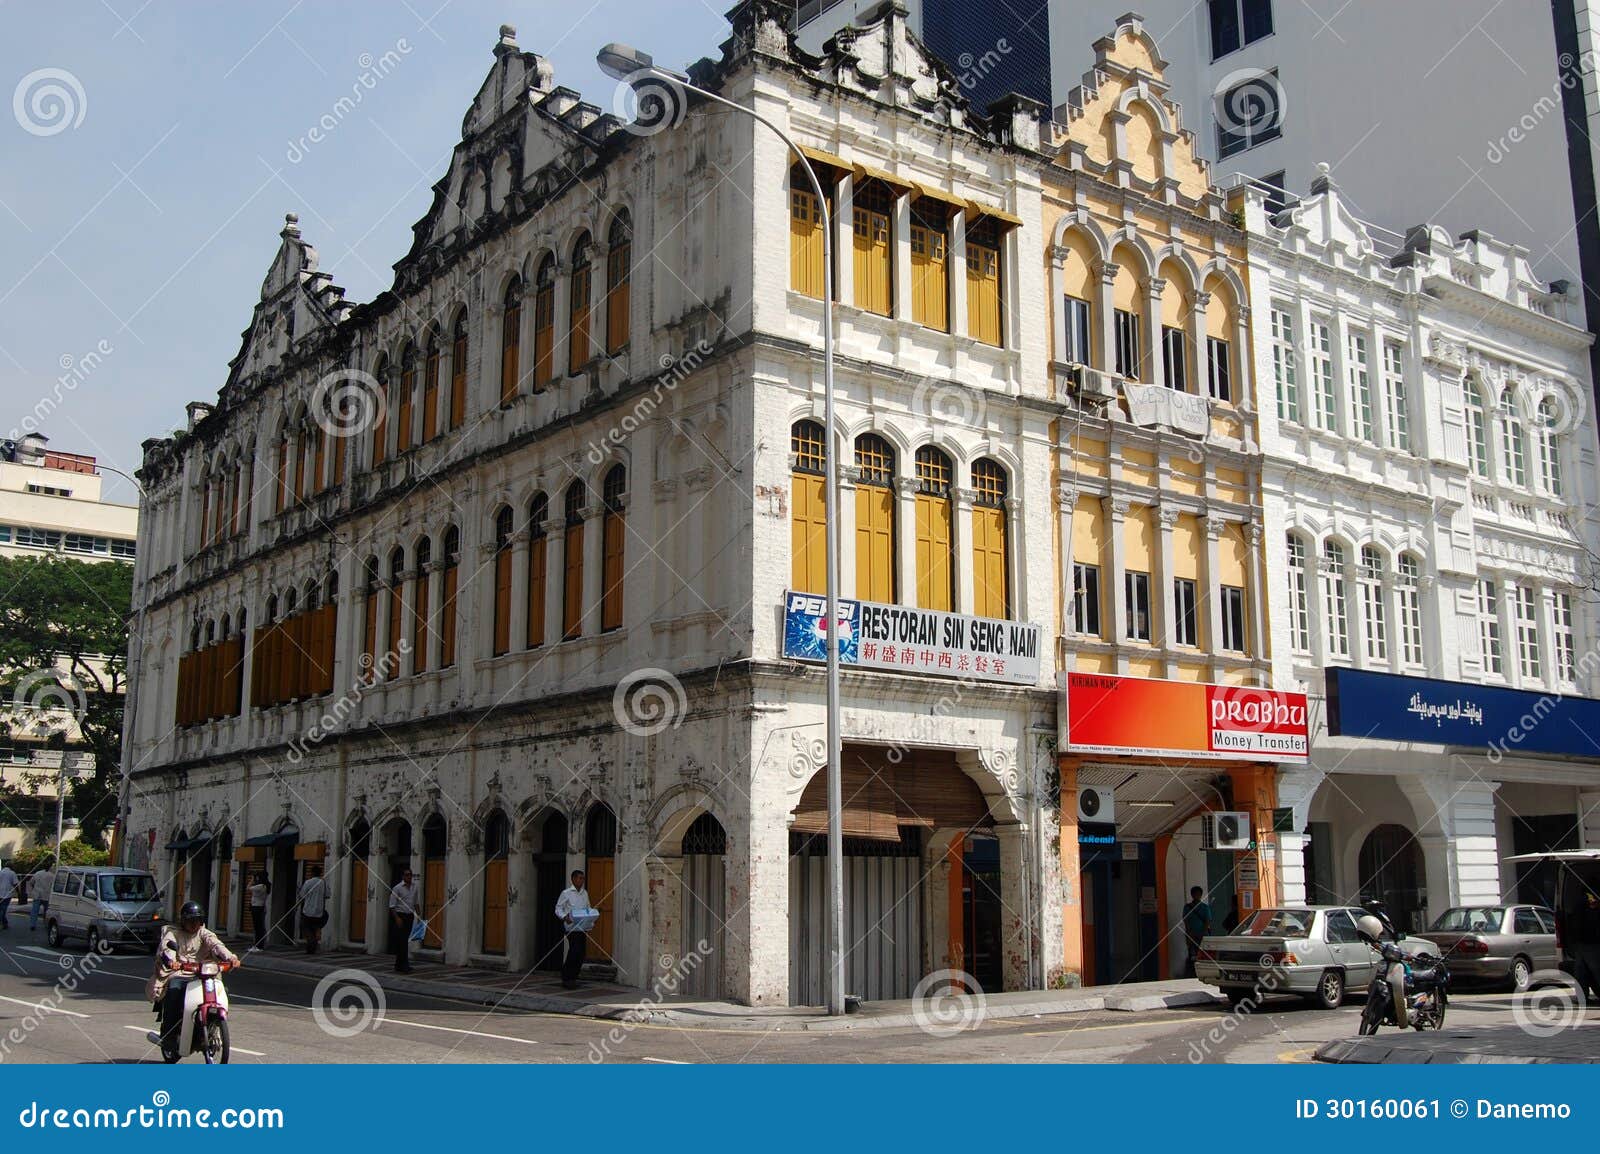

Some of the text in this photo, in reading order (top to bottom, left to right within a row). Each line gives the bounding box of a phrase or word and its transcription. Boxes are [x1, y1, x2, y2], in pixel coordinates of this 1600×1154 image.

[861, 606, 1037, 658] RESTORAN SIN SENG NAM
[863, 641, 1007, 676] 新盛南中西茶餐室
[1214, 731, 1306, 750] Money Transfer
